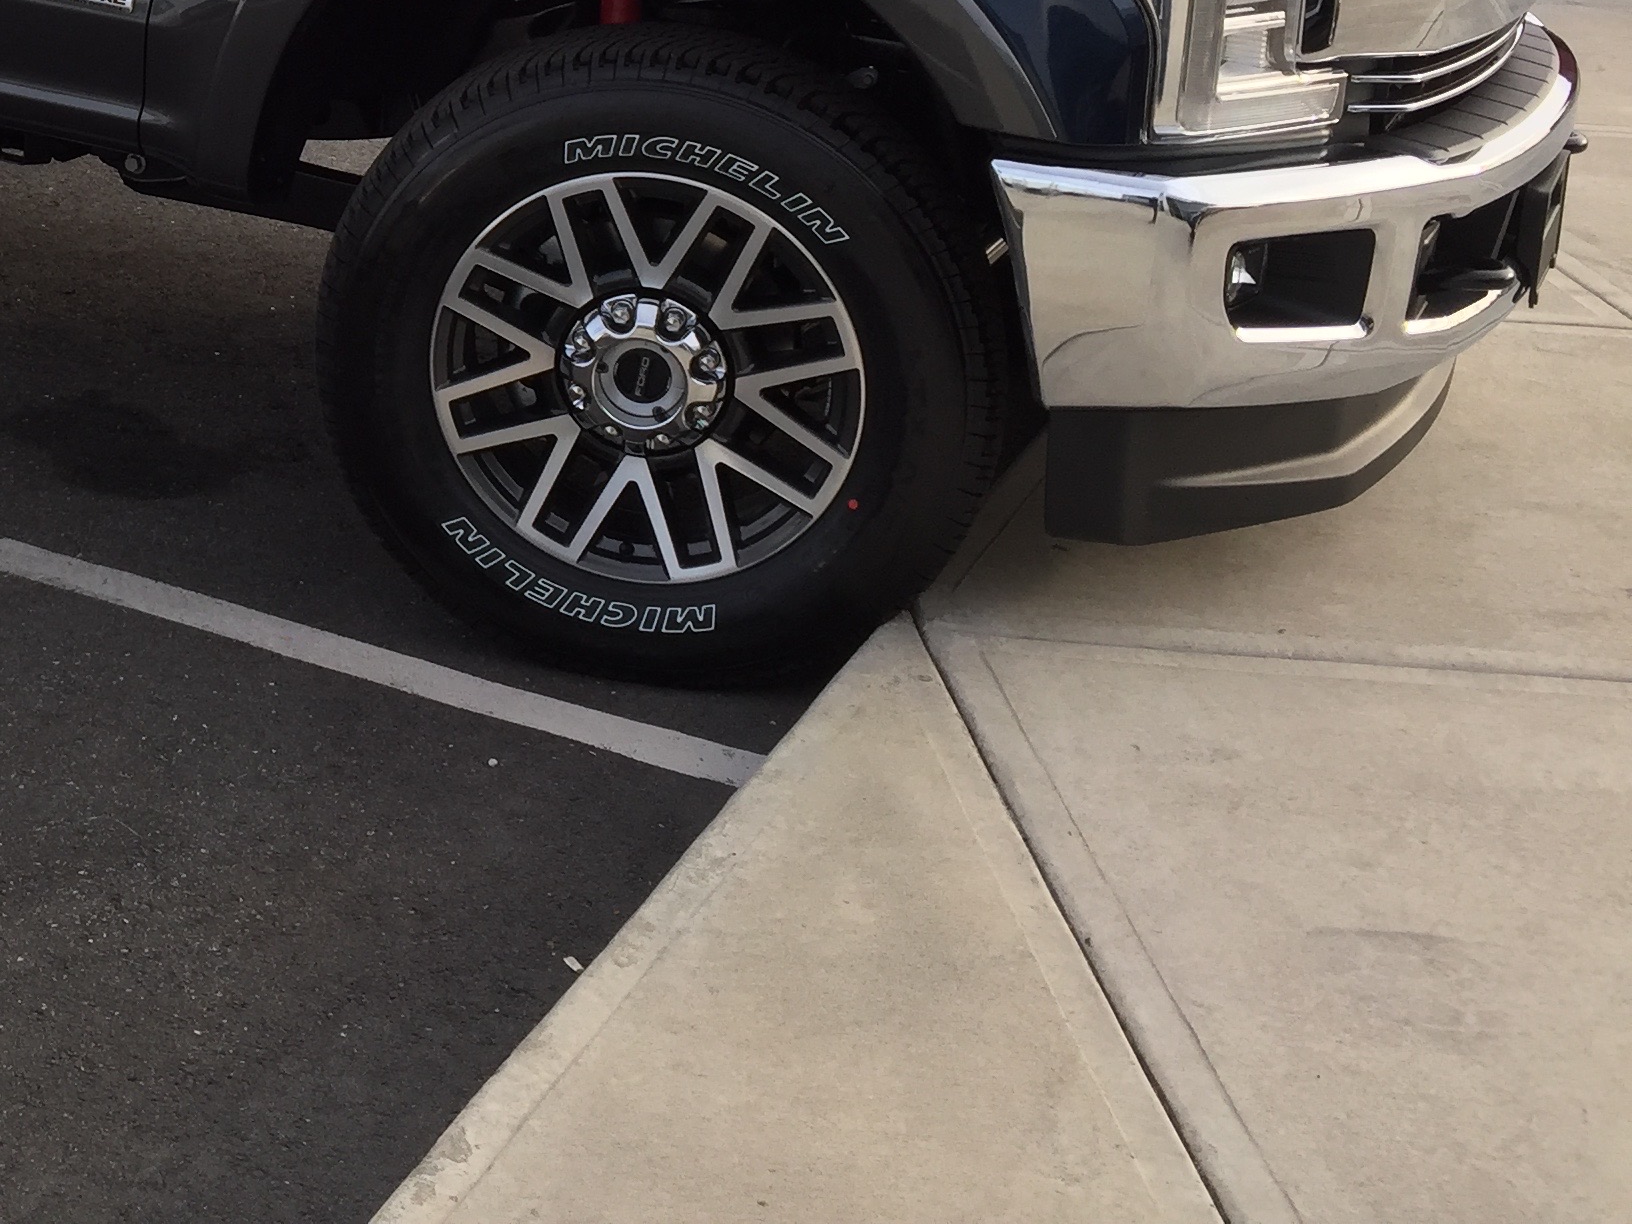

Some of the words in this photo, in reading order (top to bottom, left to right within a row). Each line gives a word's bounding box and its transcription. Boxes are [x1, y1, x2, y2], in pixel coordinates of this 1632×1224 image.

[564, 134, 850, 245] MICHELIN
[634, 356, 650, 396] FORD
[441, 516, 716, 633] MICHELIN
